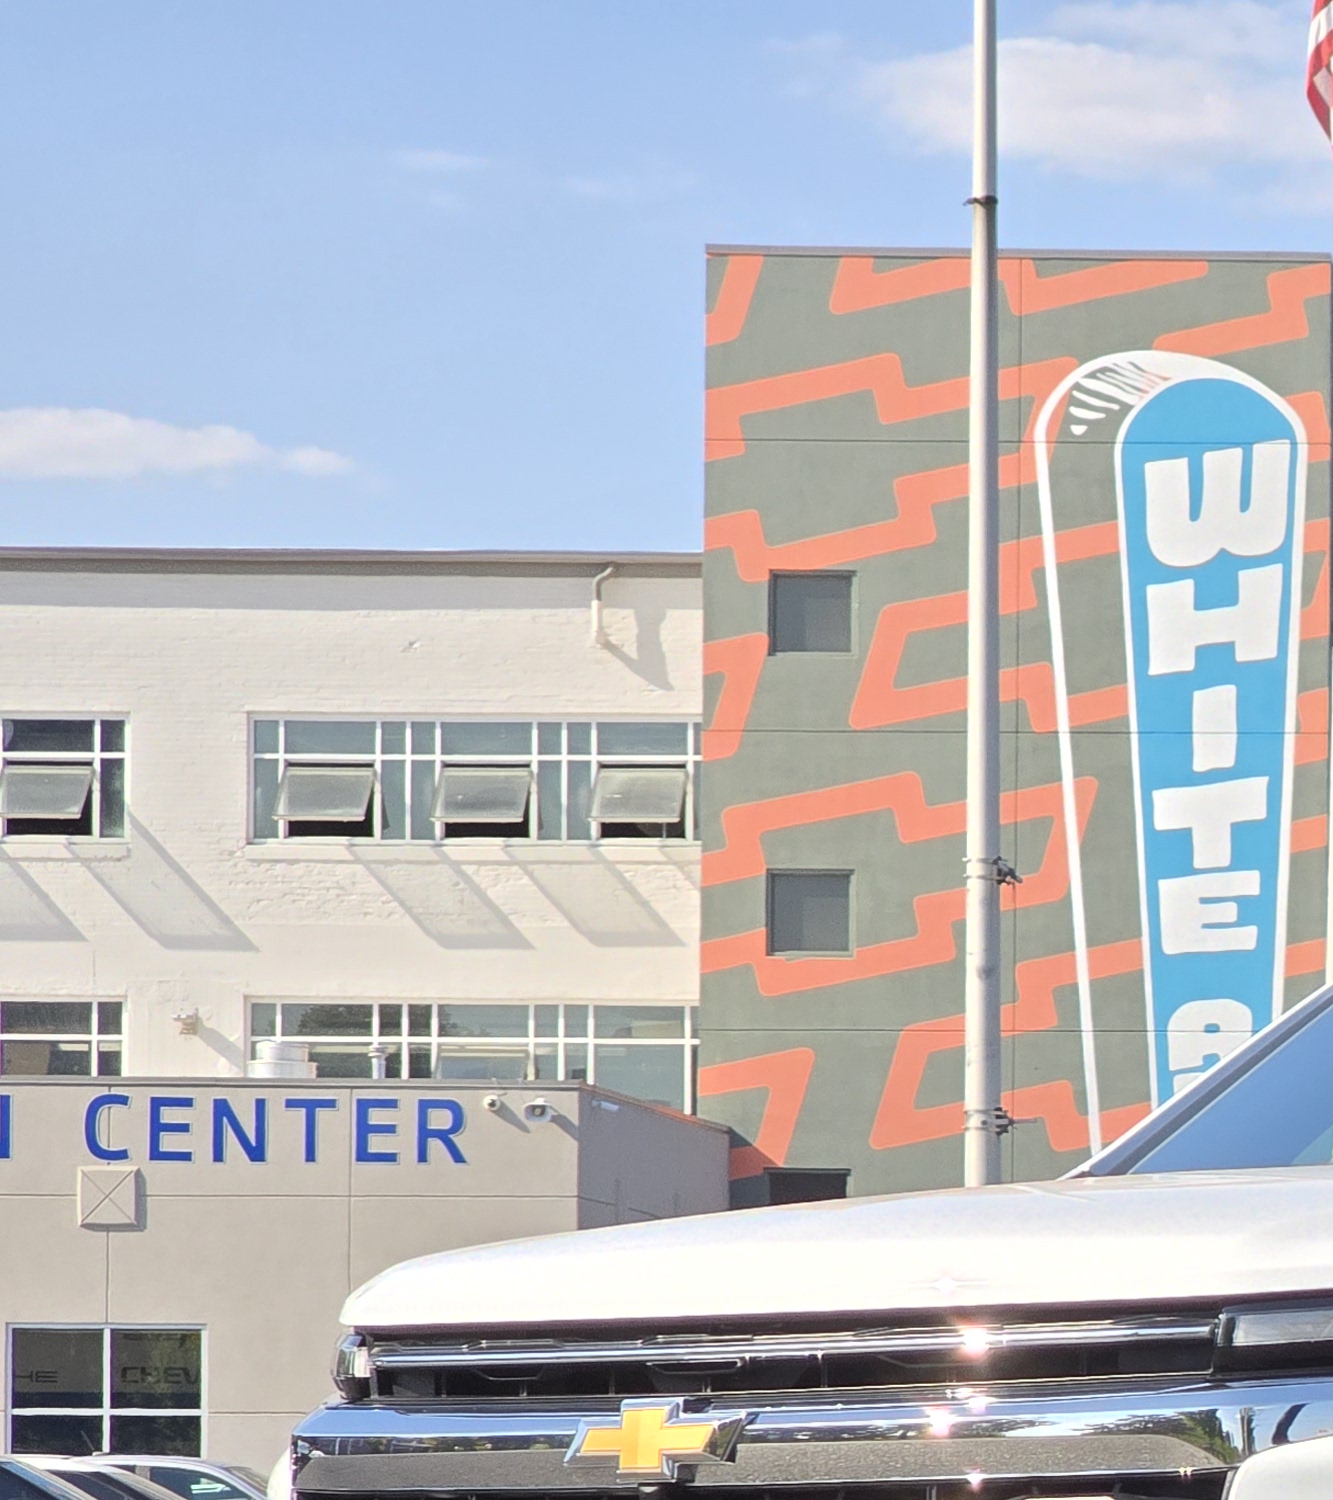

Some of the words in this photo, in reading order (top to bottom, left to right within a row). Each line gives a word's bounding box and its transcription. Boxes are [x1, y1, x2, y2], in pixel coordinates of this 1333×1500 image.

[1144, 438, 1291, 955] WHITE
[1167, 998, 1253, 1095] A
[84, 1093, 469, 1165] CENTER
